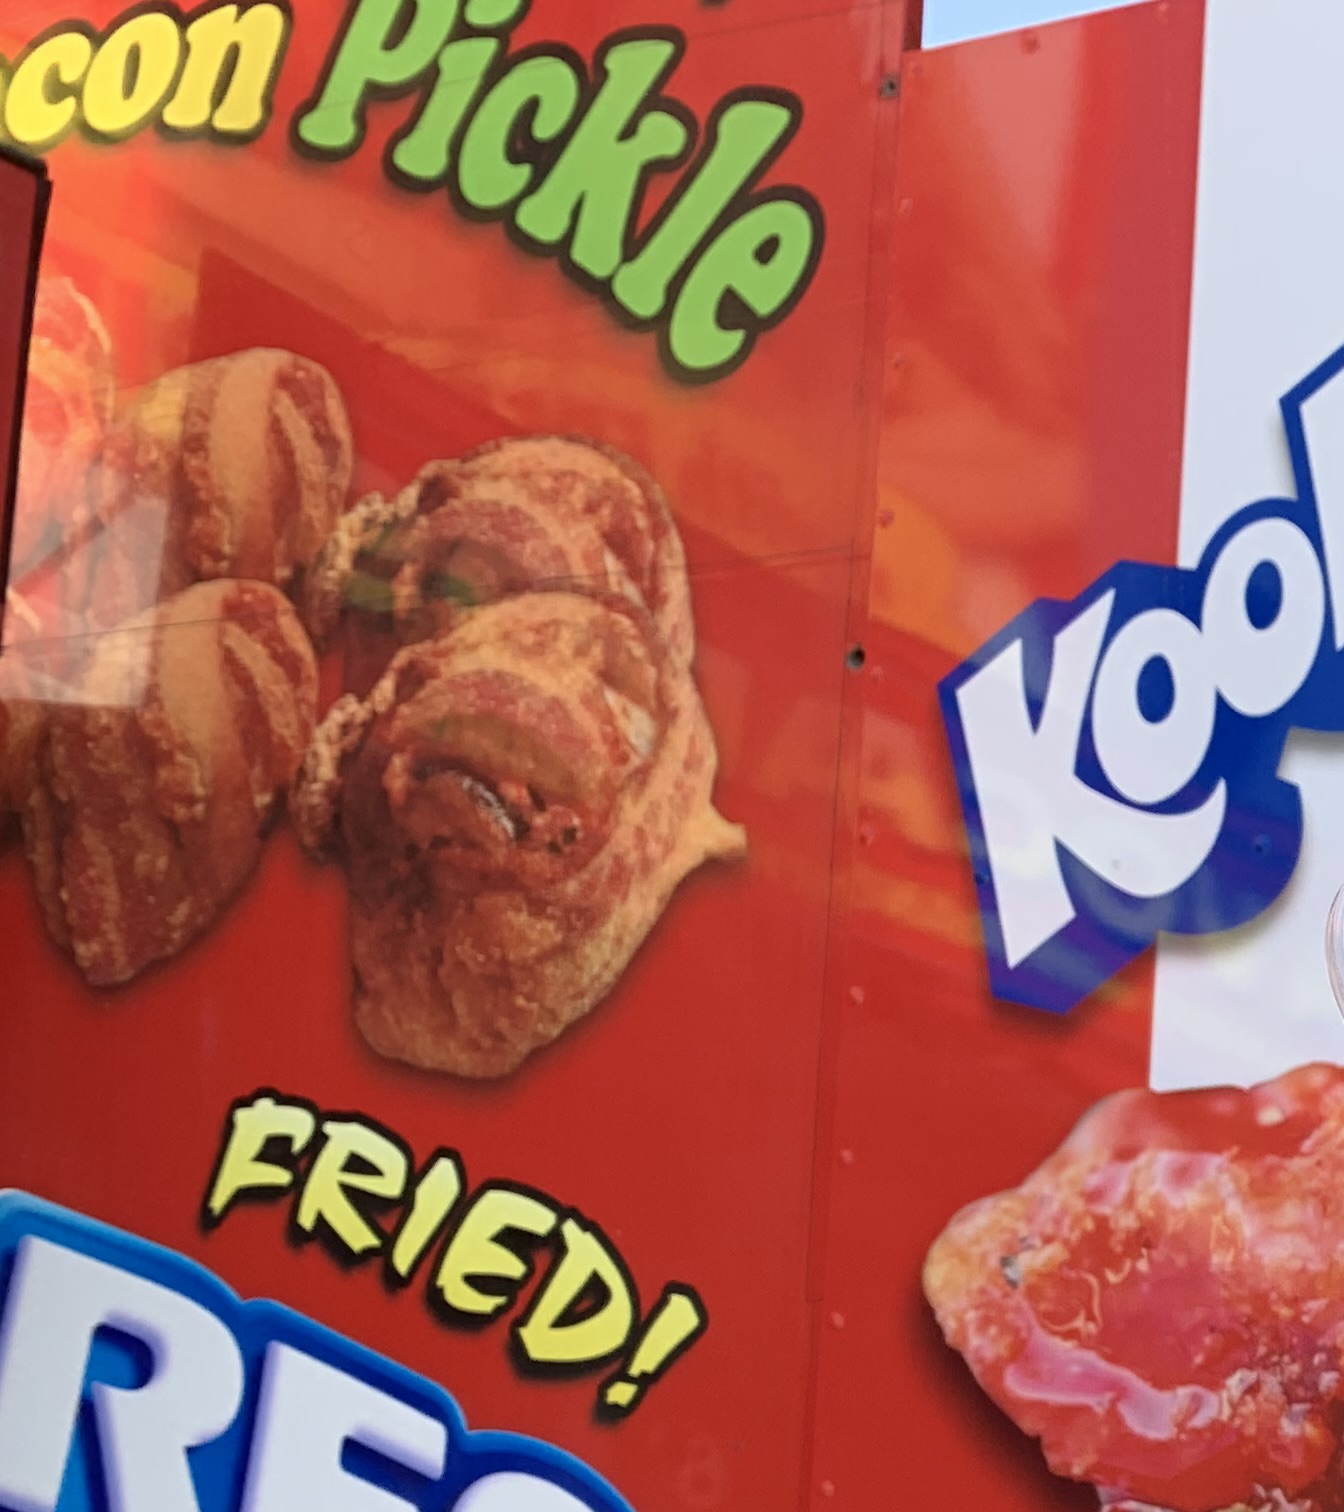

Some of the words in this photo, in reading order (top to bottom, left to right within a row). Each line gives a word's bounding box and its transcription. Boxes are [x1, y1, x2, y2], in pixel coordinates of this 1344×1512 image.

[0, 0, 292, 145] con
[297, 0, 818, 372] Pickle
[208, 1095, 706, 1410] FRIED!
